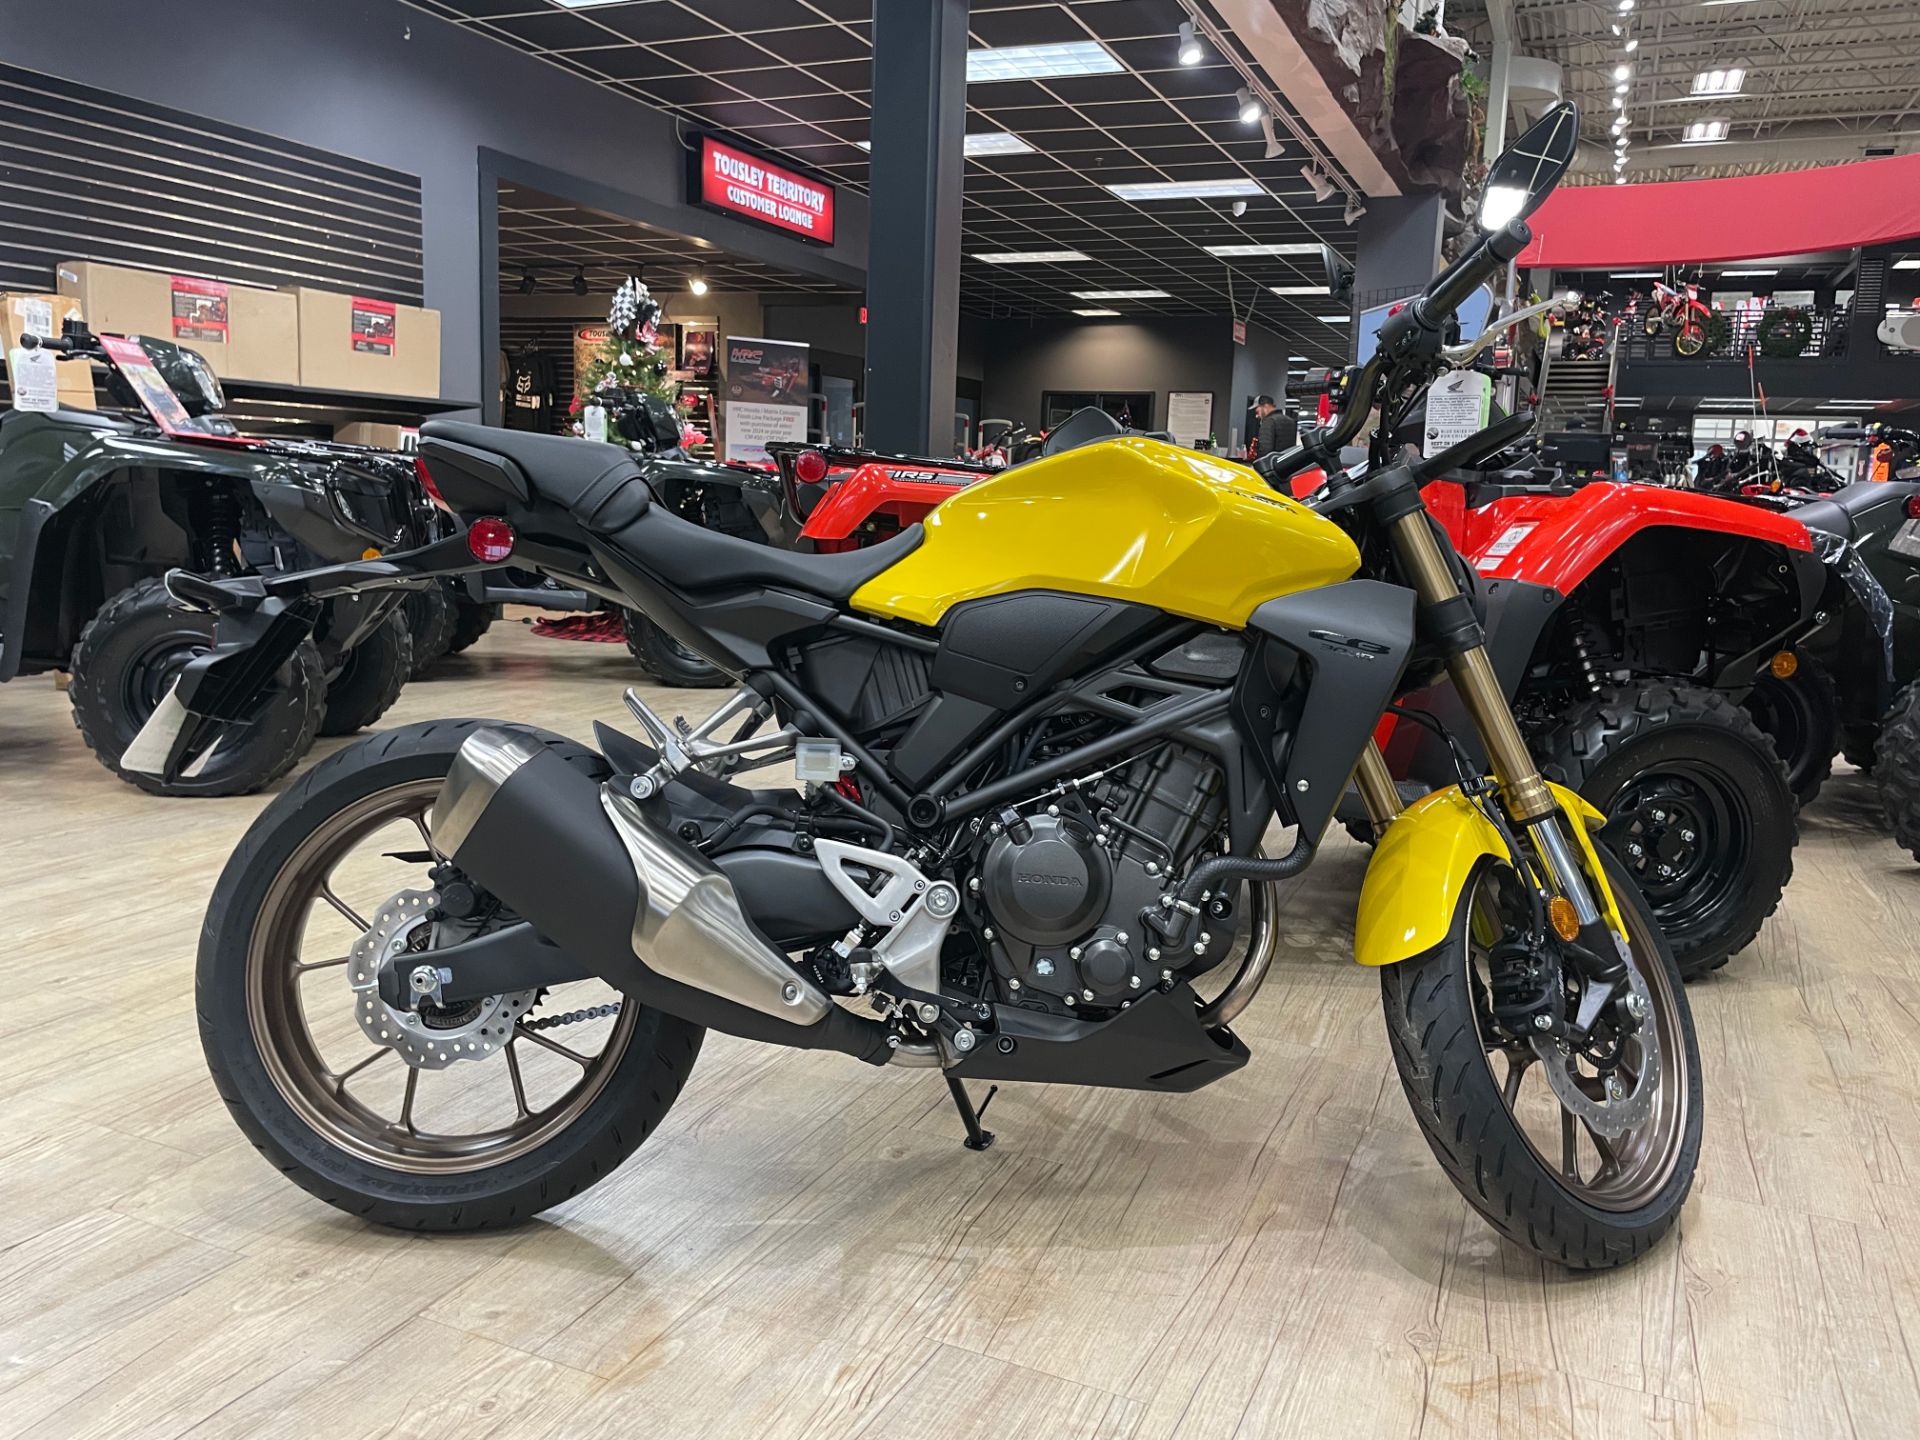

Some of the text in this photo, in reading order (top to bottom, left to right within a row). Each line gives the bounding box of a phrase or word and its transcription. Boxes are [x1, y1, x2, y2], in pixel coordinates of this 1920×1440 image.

[713, 151, 825, 212] TOUSLEY TERRITORY
[727, 185, 813, 229] CUSTOMER LOUNGE
[893, 470, 935, 480] IRS
[1017, 873, 1083, 887] HONDA
